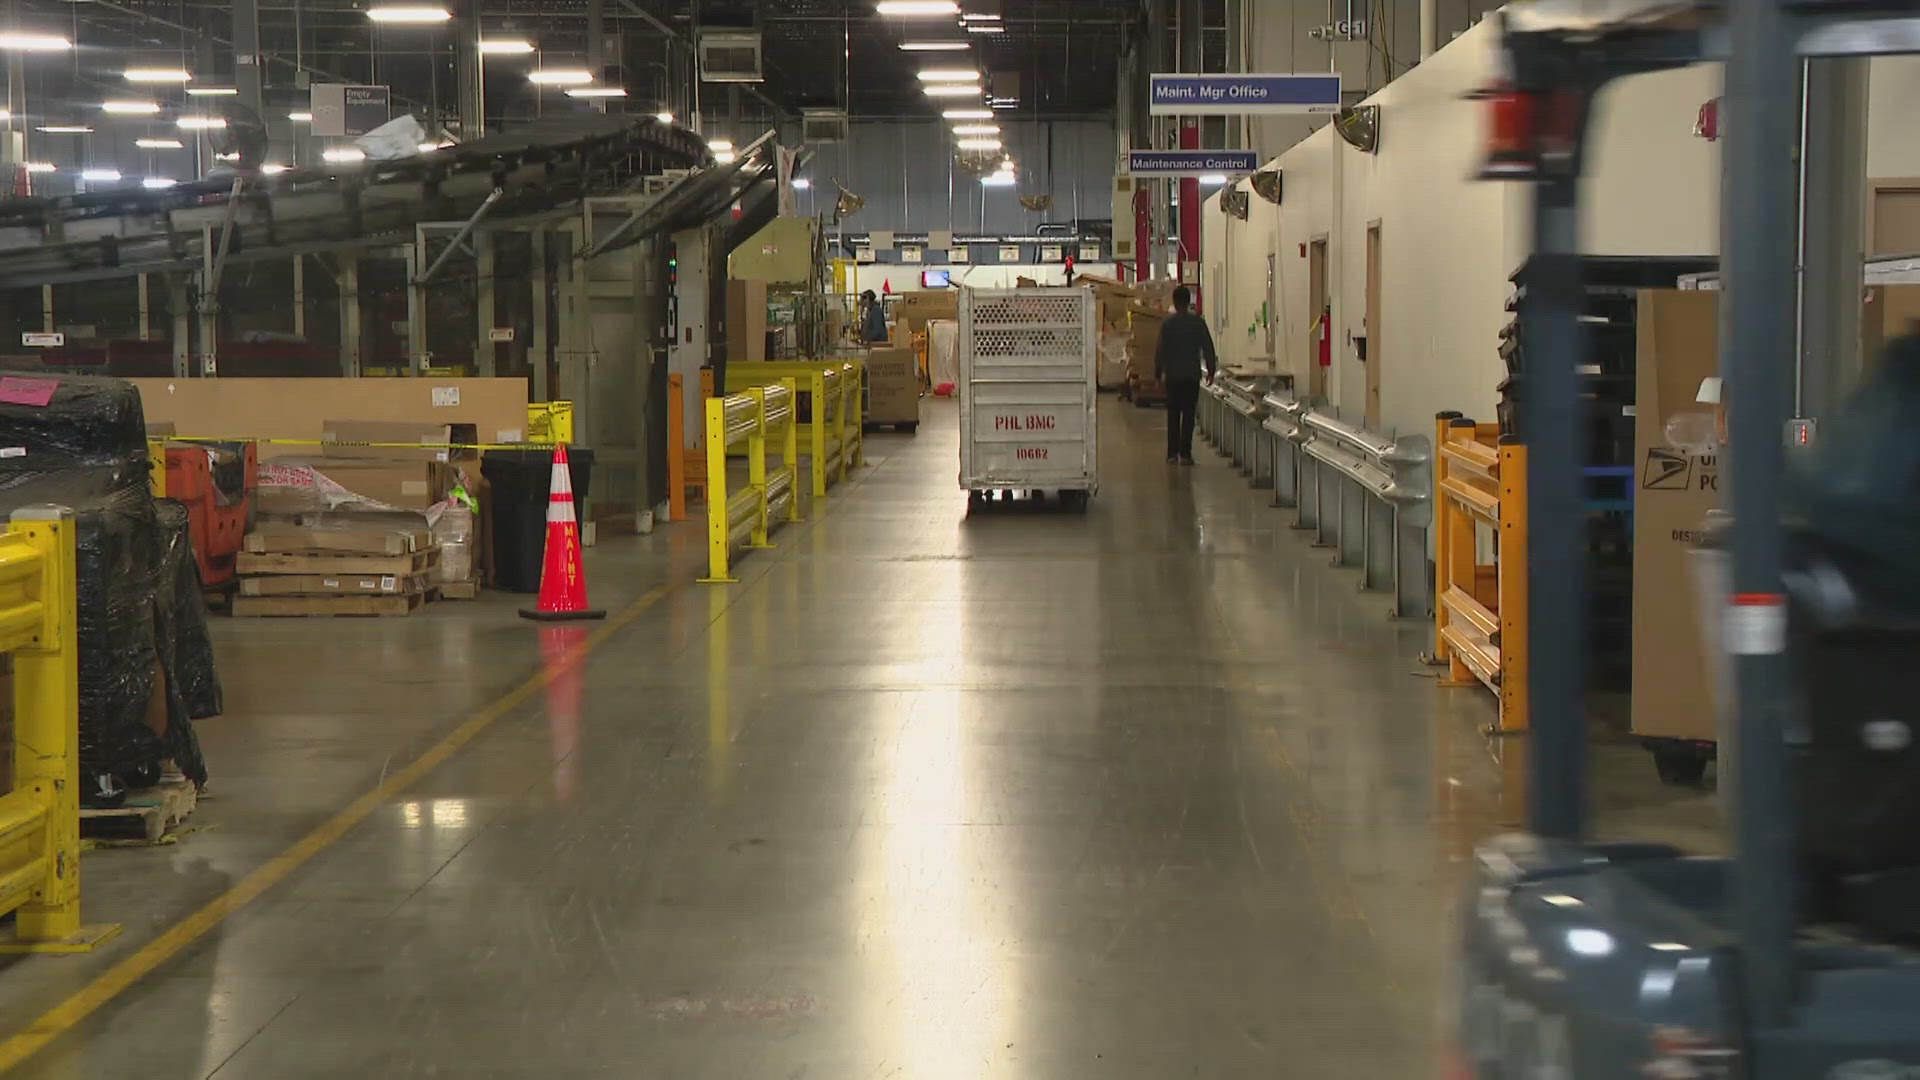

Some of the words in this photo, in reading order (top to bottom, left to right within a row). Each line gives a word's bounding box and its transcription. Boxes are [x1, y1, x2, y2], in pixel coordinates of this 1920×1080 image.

[346, 89, 370, 98] Empty
[1156, 86, 1195, 98] Maint.
[1200, 86, 1226, 100] Mgr
[1229, 86, 1268, 98] Office
[346, 97, 386, 106] Equipment
[1132, 158, 1203, 169] Maintenance
[1206, 158, 1248, 169] Control
[995, 415, 1022, 431] PHL
[1026, 415, 1055, 430] BMC
[564, 525, 576, 587] MAINT
